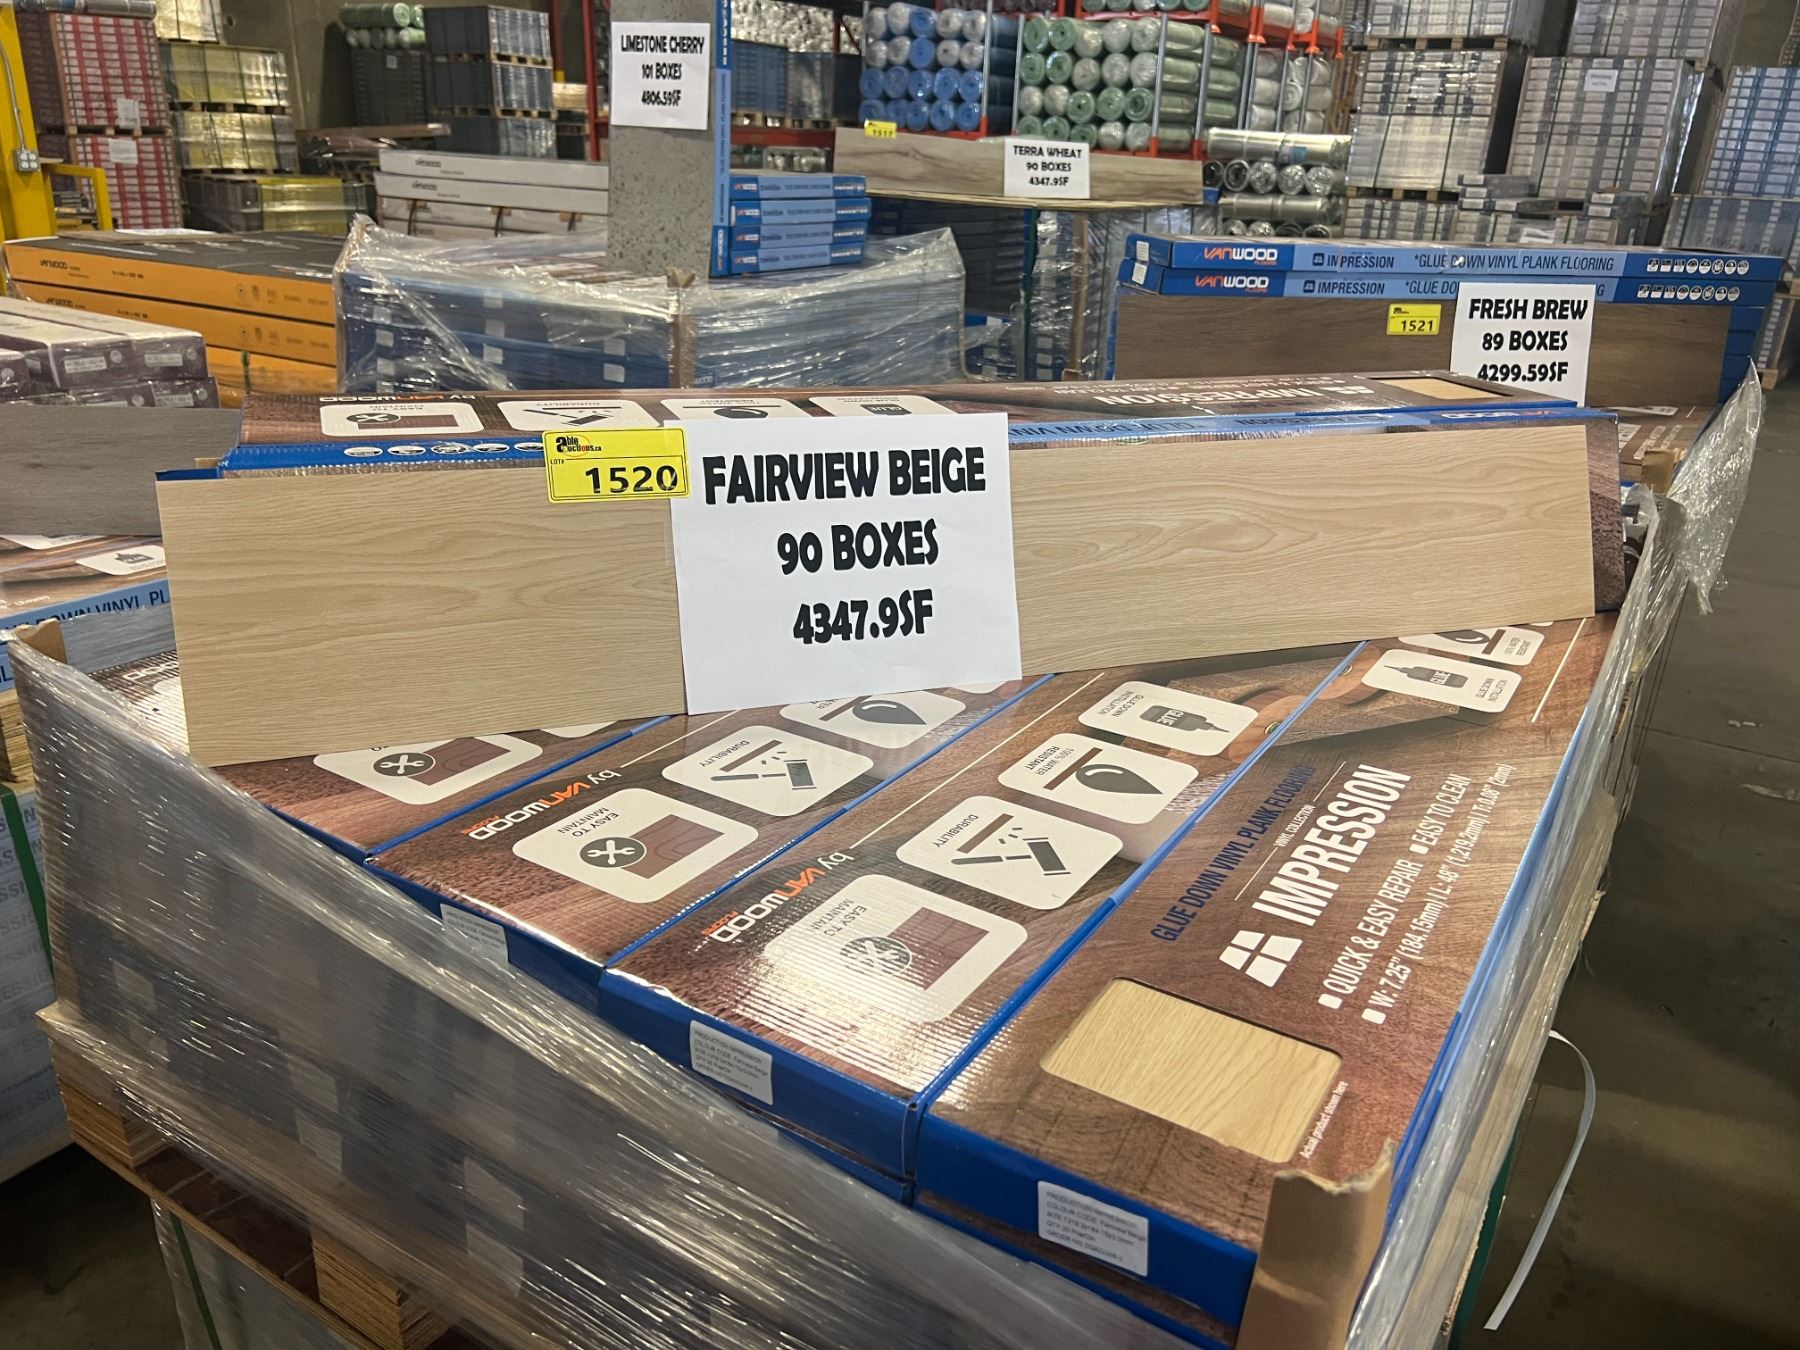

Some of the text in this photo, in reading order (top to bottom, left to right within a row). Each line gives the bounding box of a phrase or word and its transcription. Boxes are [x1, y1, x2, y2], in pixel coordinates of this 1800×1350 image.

[621, 35, 705, 54] LIMESTONE CHERRY
[642, 62, 682, 80] 101 BOXES
[1013, 145, 1082, 159] TERRA WHEAT
[1026, 162, 1071, 172] 90 BOXES
[1028, 176, 1069, 186] 4347.9SF
[1203, 247, 1278, 262] VANWOOD
[1451, 255, 1486, 269] DOWN
[1488, 255, 1518, 269] VINYL
[1522, 256, 1558, 270] PLANK
[1560, 257, 1614, 271] FLOORING
[1195, 274, 1270, 290] VANWOOD
[1317, 280, 1385, 296] IMPRESSION
[1469, 298, 1588, 320] FRESH BREW
[1401, 320, 1433, 332] 1521
[1482, 330, 1568, 351] 89 BOXES
[1477, 362, 1569, 382] 4299.59SF
[1093, 386, 1325, 405] IMPRESSION
[585, 465, 678, 494] 1520
[703, 447, 986, 504] FAIRVIEW BEIGE
[778, 519, 938, 575] 90 BOXES
[794, 589, 933, 644] 4347.9SF
[1430, 670, 1452, 685] GLUE
[1098, 690, 1134, 716] INSTALLATION
[1113, 694, 1145, 718] GLUE DOWN
[1157, 709, 1185, 726] GLUE
[700, 740, 750, 768] DURABILITY
[1025, 745, 1060, 771] RESISTANT
[1036, 760, 1058, 776] WATER
[468, 769, 622, 840] by VANWOOD
[558, 807, 610, 834] MAINTAIN
[572, 812, 620, 837] EASY TO
[933, 814, 979, 848] DURABILITY
[1273, 804, 1315, 848] VINYL COLLECTION
[1151, 765, 1317, 941] GLUE DOWN VINYL PLANK FLOORING
[1251, 764, 1412, 927] IMPRESSION
[1323, 773, 1472, 995] QUICK & EASY REPAIR EASY TO CLEAN
[1368, 989, 1398, 1008] W:
[1395, 898, 1449, 960] (184.15mm)
[1429, 882, 1453, 895] L:
[1444, 815, 1490, 868] (1,219.2mm)
[1488, 763, 1517, 787] (2mm)
[709, 852, 855, 943] by VANWOOD
[810, 898, 855, 931] MAINTAIN
[823, 905, 868, 937] EASY TO
[1299, 1081, 1349, 1159] Actual product shown here
